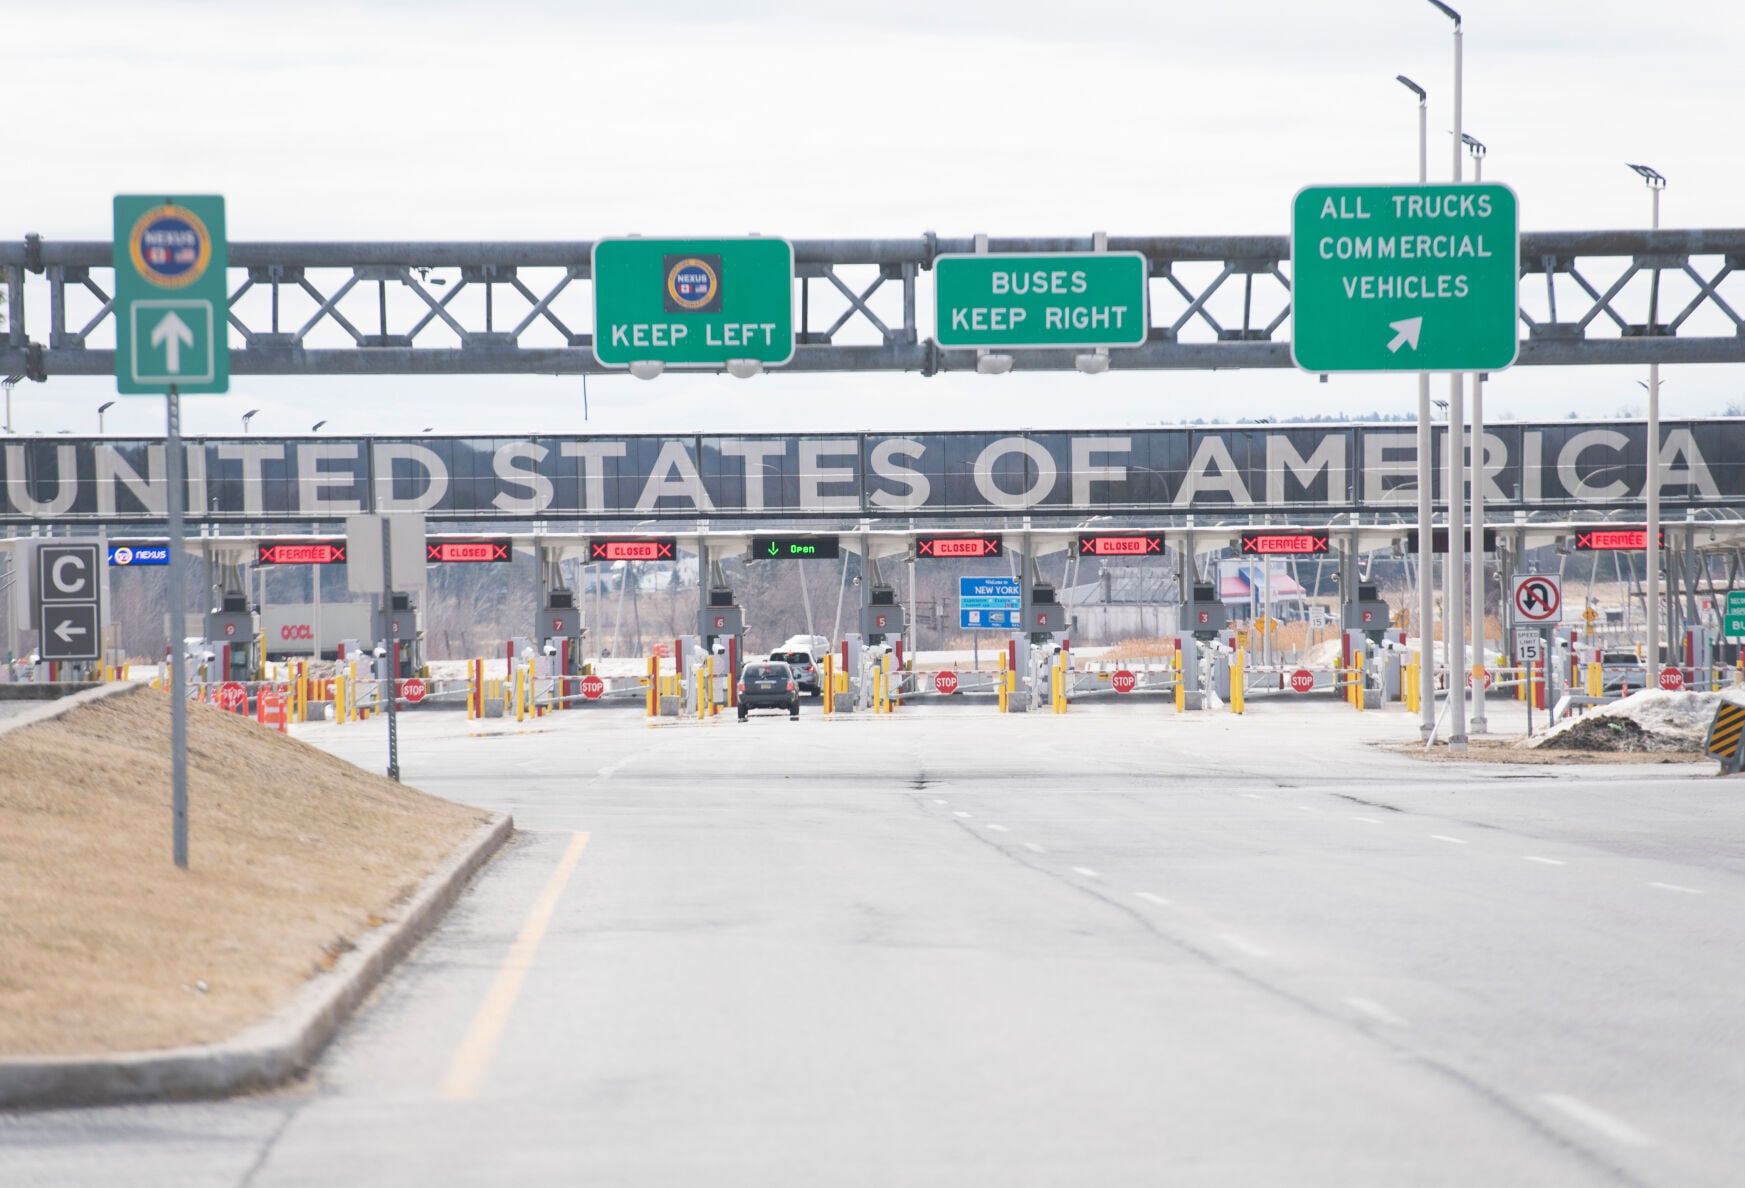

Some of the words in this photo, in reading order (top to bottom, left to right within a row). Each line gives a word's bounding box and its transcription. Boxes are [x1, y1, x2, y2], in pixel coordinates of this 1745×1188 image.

[1320, 196, 1371, 219] ALL
[1392, 194, 1492, 218] TRUCKS
[1319, 235, 1492, 259] COMMERCIAL
[677, 274, 708, 283] NEXUS
[992, 271, 1087, 295] BUSES
[1342, 275, 1469, 299] VEHICLES
[952, 307, 1027, 330] KEEP
[1045, 306, 1127, 329] RIGHT
[611, 323, 688, 347] KEEP
[706, 323, 776, 346] LEFT
[5, 443, 449, 518] UNITED
[491, 438, 931, 515] STATES
[973, 436, 1132, 509] OF
[1171, 428, 1722, 506] AMERICA
[1261, 536, 1308, 550] FERMÉE
[1595, 531, 1643, 546] FERMÉE
[614, 546, 651, 556] CLOSED
[790, 544, 815, 553] Open
[941, 542, 977, 553] CLOSED
[1103, 540, 1140, 551] CLOSED
[279, 546, 327, 559] FERMÉE
[450, 547, 487, 557] CLOSED
[52, 555, 86, 593] C
[975, 586, 994, 595] NEW
[996, 586, 1019, 595] YORK
[717, 618, 725, 627] 6
[879, 617, 887, 627] 5
[1039, 616, 1047, 625] 4
[1201, 613, 1209, 623] 3
[1312, 618, 1322, 626] 15
[1364, 613, 1373, 623] 2
[227, 626, 235, 636] 9
[555, 621, 563, 630] 7
[281, 624, 314, 640] OOCL
[1520, 646, 1537, 658] 15
[936, 677, 957, 688] STOP
[1113, 676, 1135, 687] STOP
[1292, 676, 1313, 687] STOP
[1661, 675, 1682, 686] STOP
[404, 684, 424, 695] STOP
[582, 682, 603, 692] STOP
